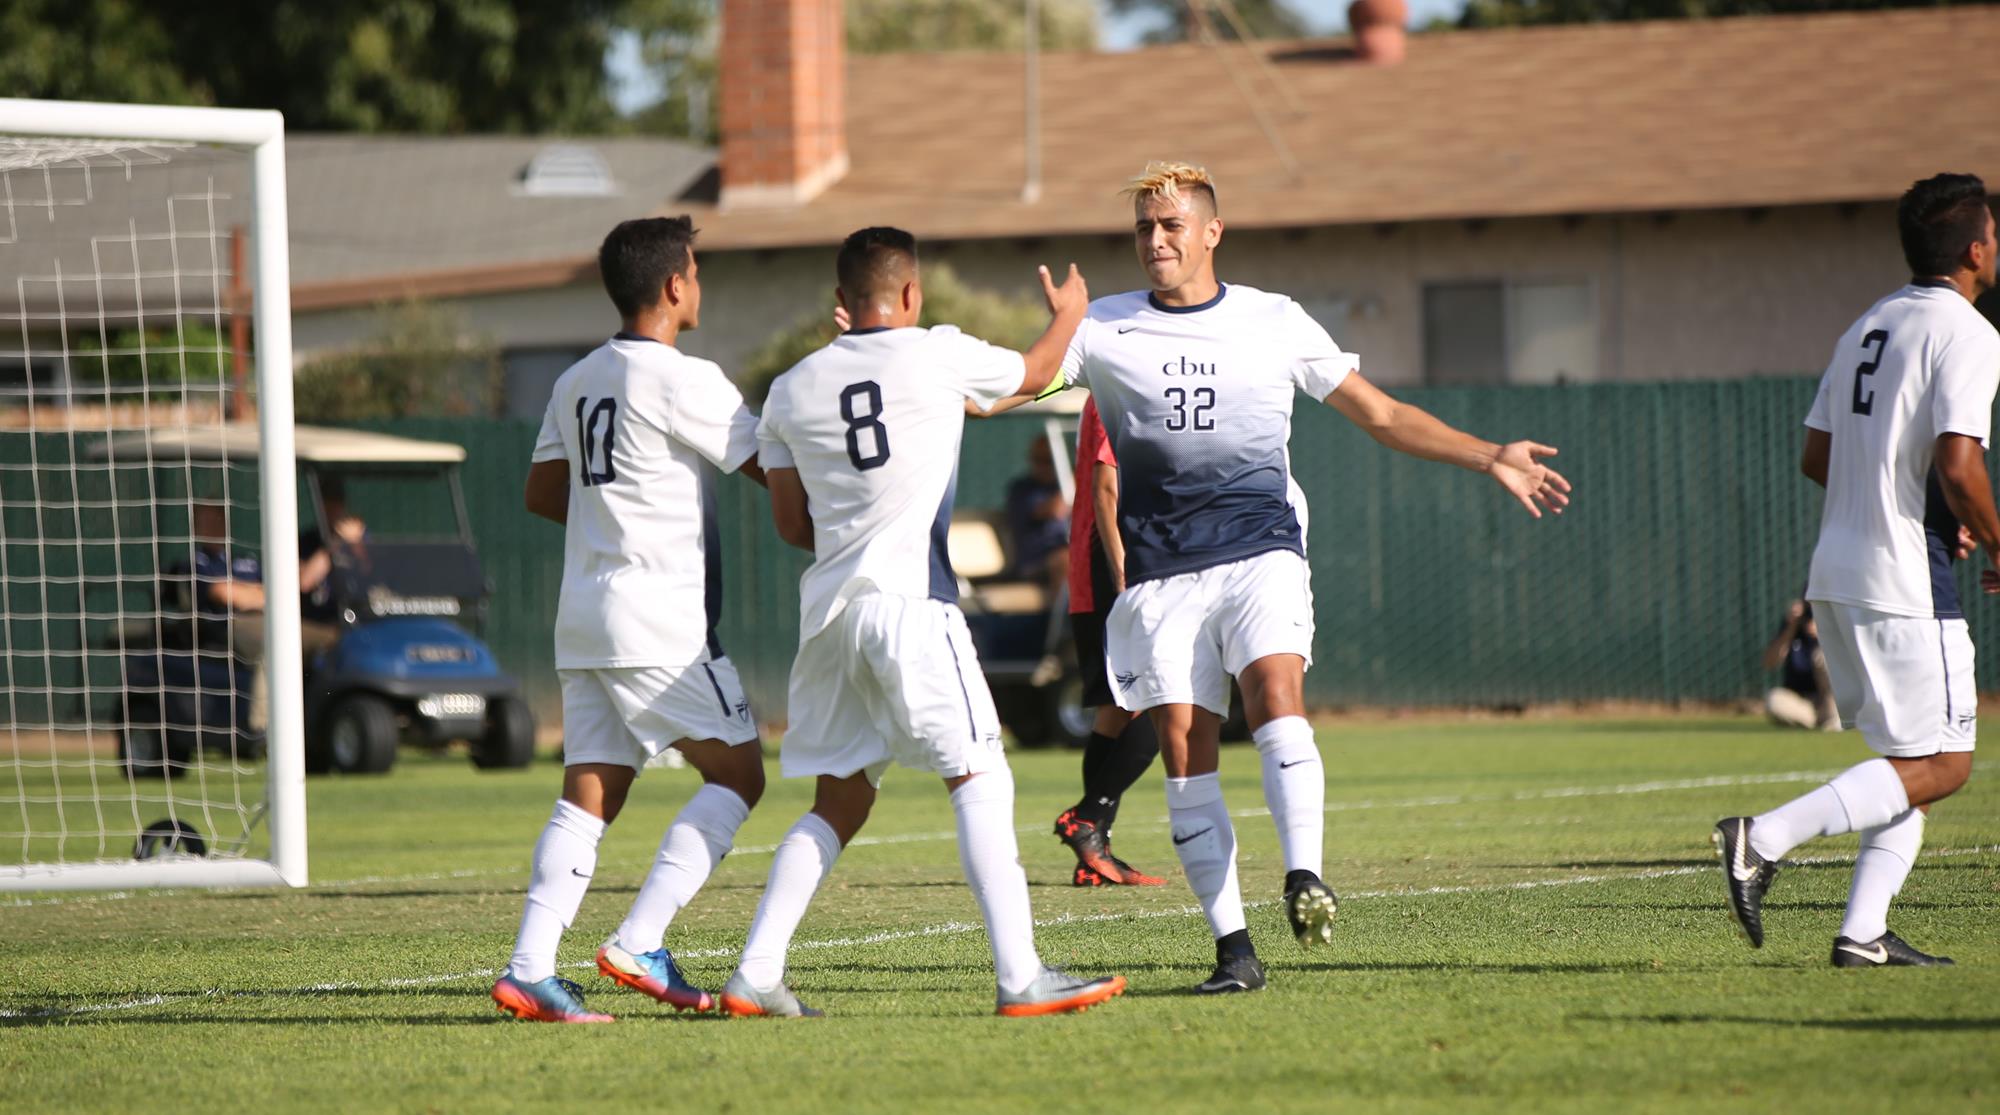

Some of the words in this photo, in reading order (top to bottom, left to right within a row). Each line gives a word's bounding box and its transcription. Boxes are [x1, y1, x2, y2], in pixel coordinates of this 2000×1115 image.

[1162, 356, 1216, 376] cbu
[1164, 387, 1216, 432] 32
[1852, 329, 1889, 416] 2
[576, 396, 617, 487] 10
[840, 380, 890, 471] 8
